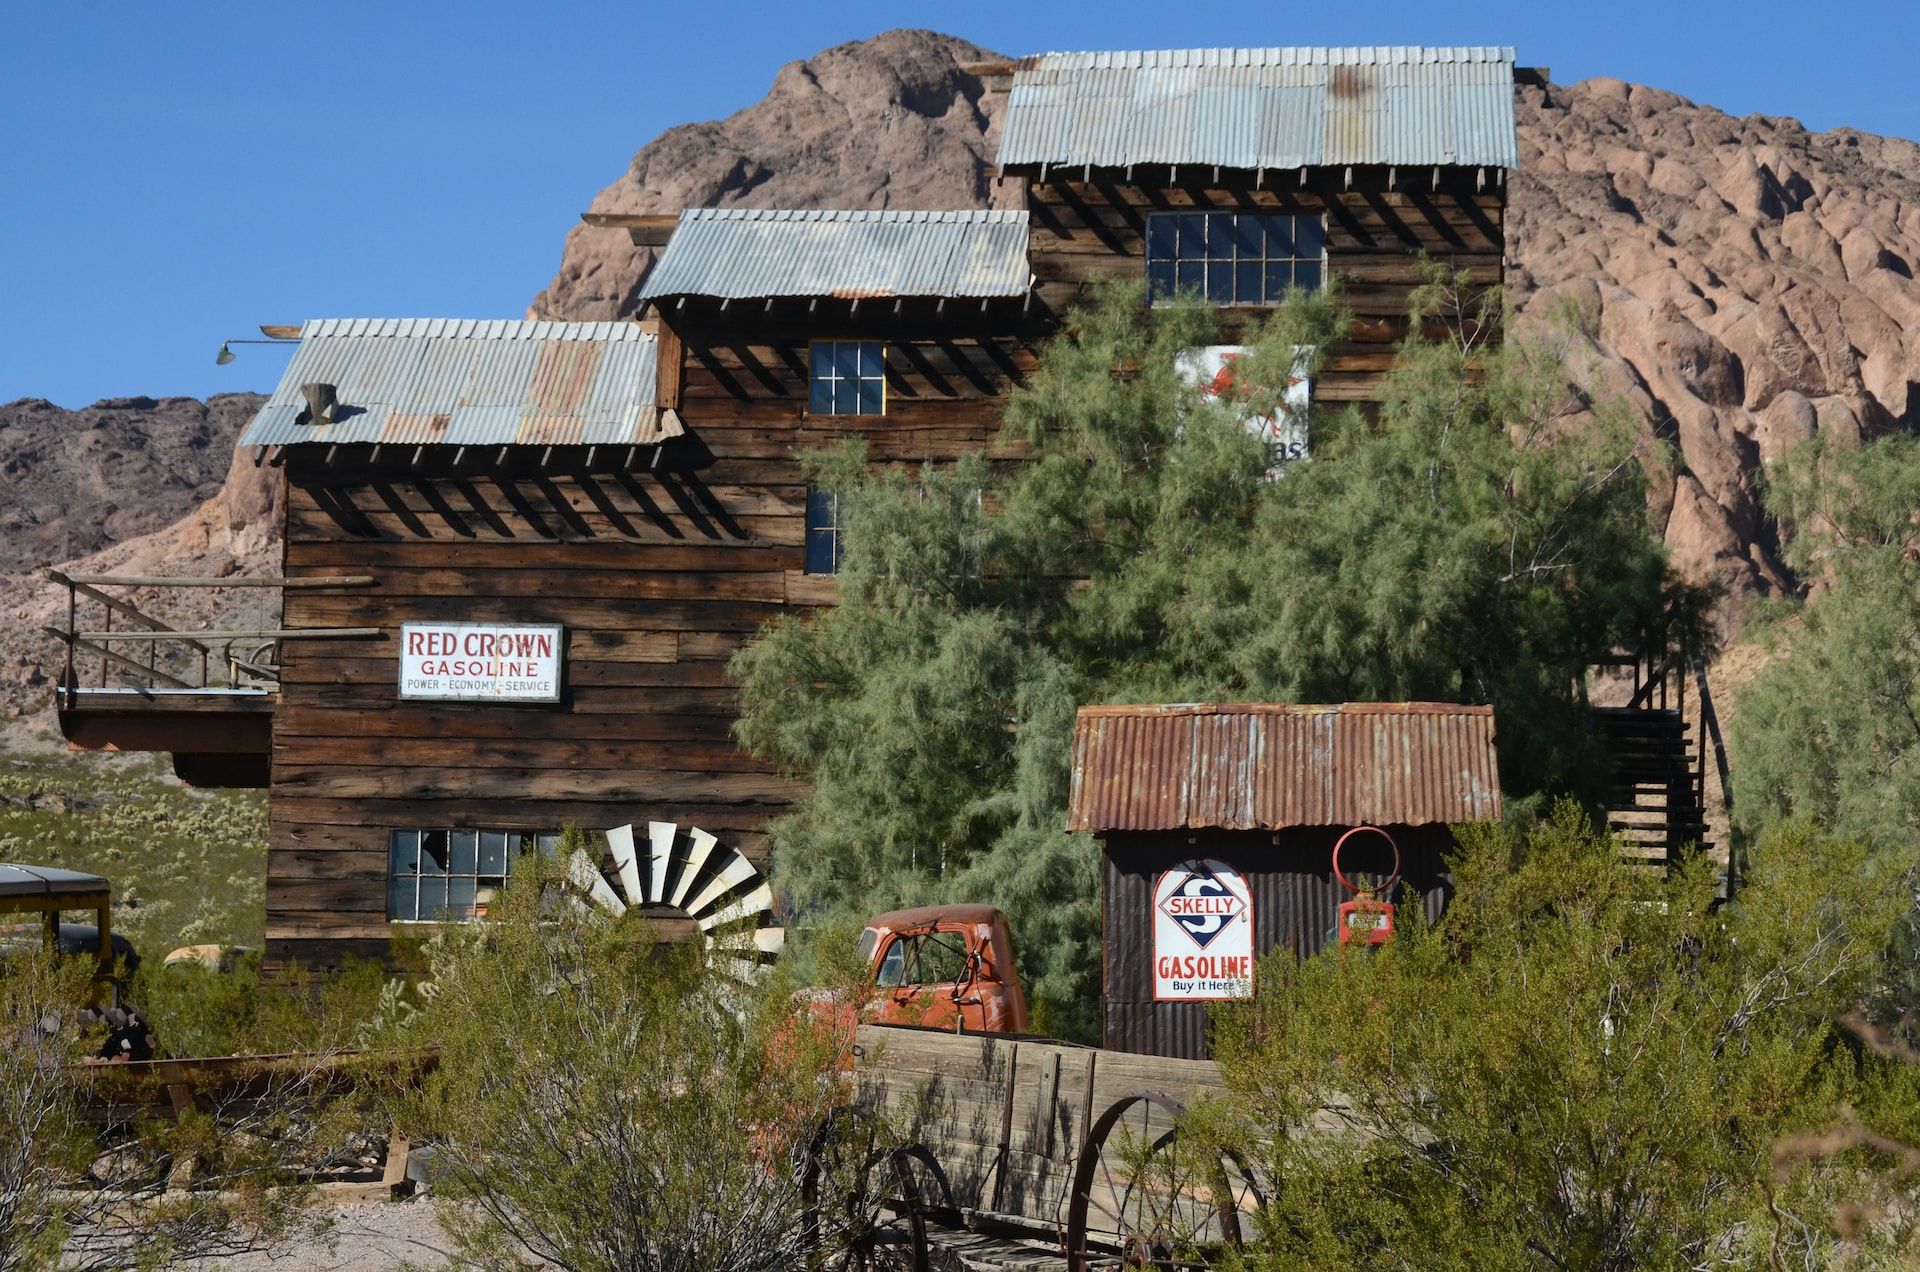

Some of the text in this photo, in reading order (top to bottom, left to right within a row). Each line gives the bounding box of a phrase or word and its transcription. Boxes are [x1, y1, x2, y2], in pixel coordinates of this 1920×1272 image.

[408, 631, 553, 658] RED CROWN
[421, 660, 539, 677] GASOLINE
[407, 679, 439, 689] POWER
[449, 679, 496, 690] ECONOMY
[505, 681, 550, 691] SERVICE
[1169, 898, 1234, 914] SKELLY
[1158, 956, 1250, 979] GASOLINE
[1172, 981, 1234, 993] Buy it Here
